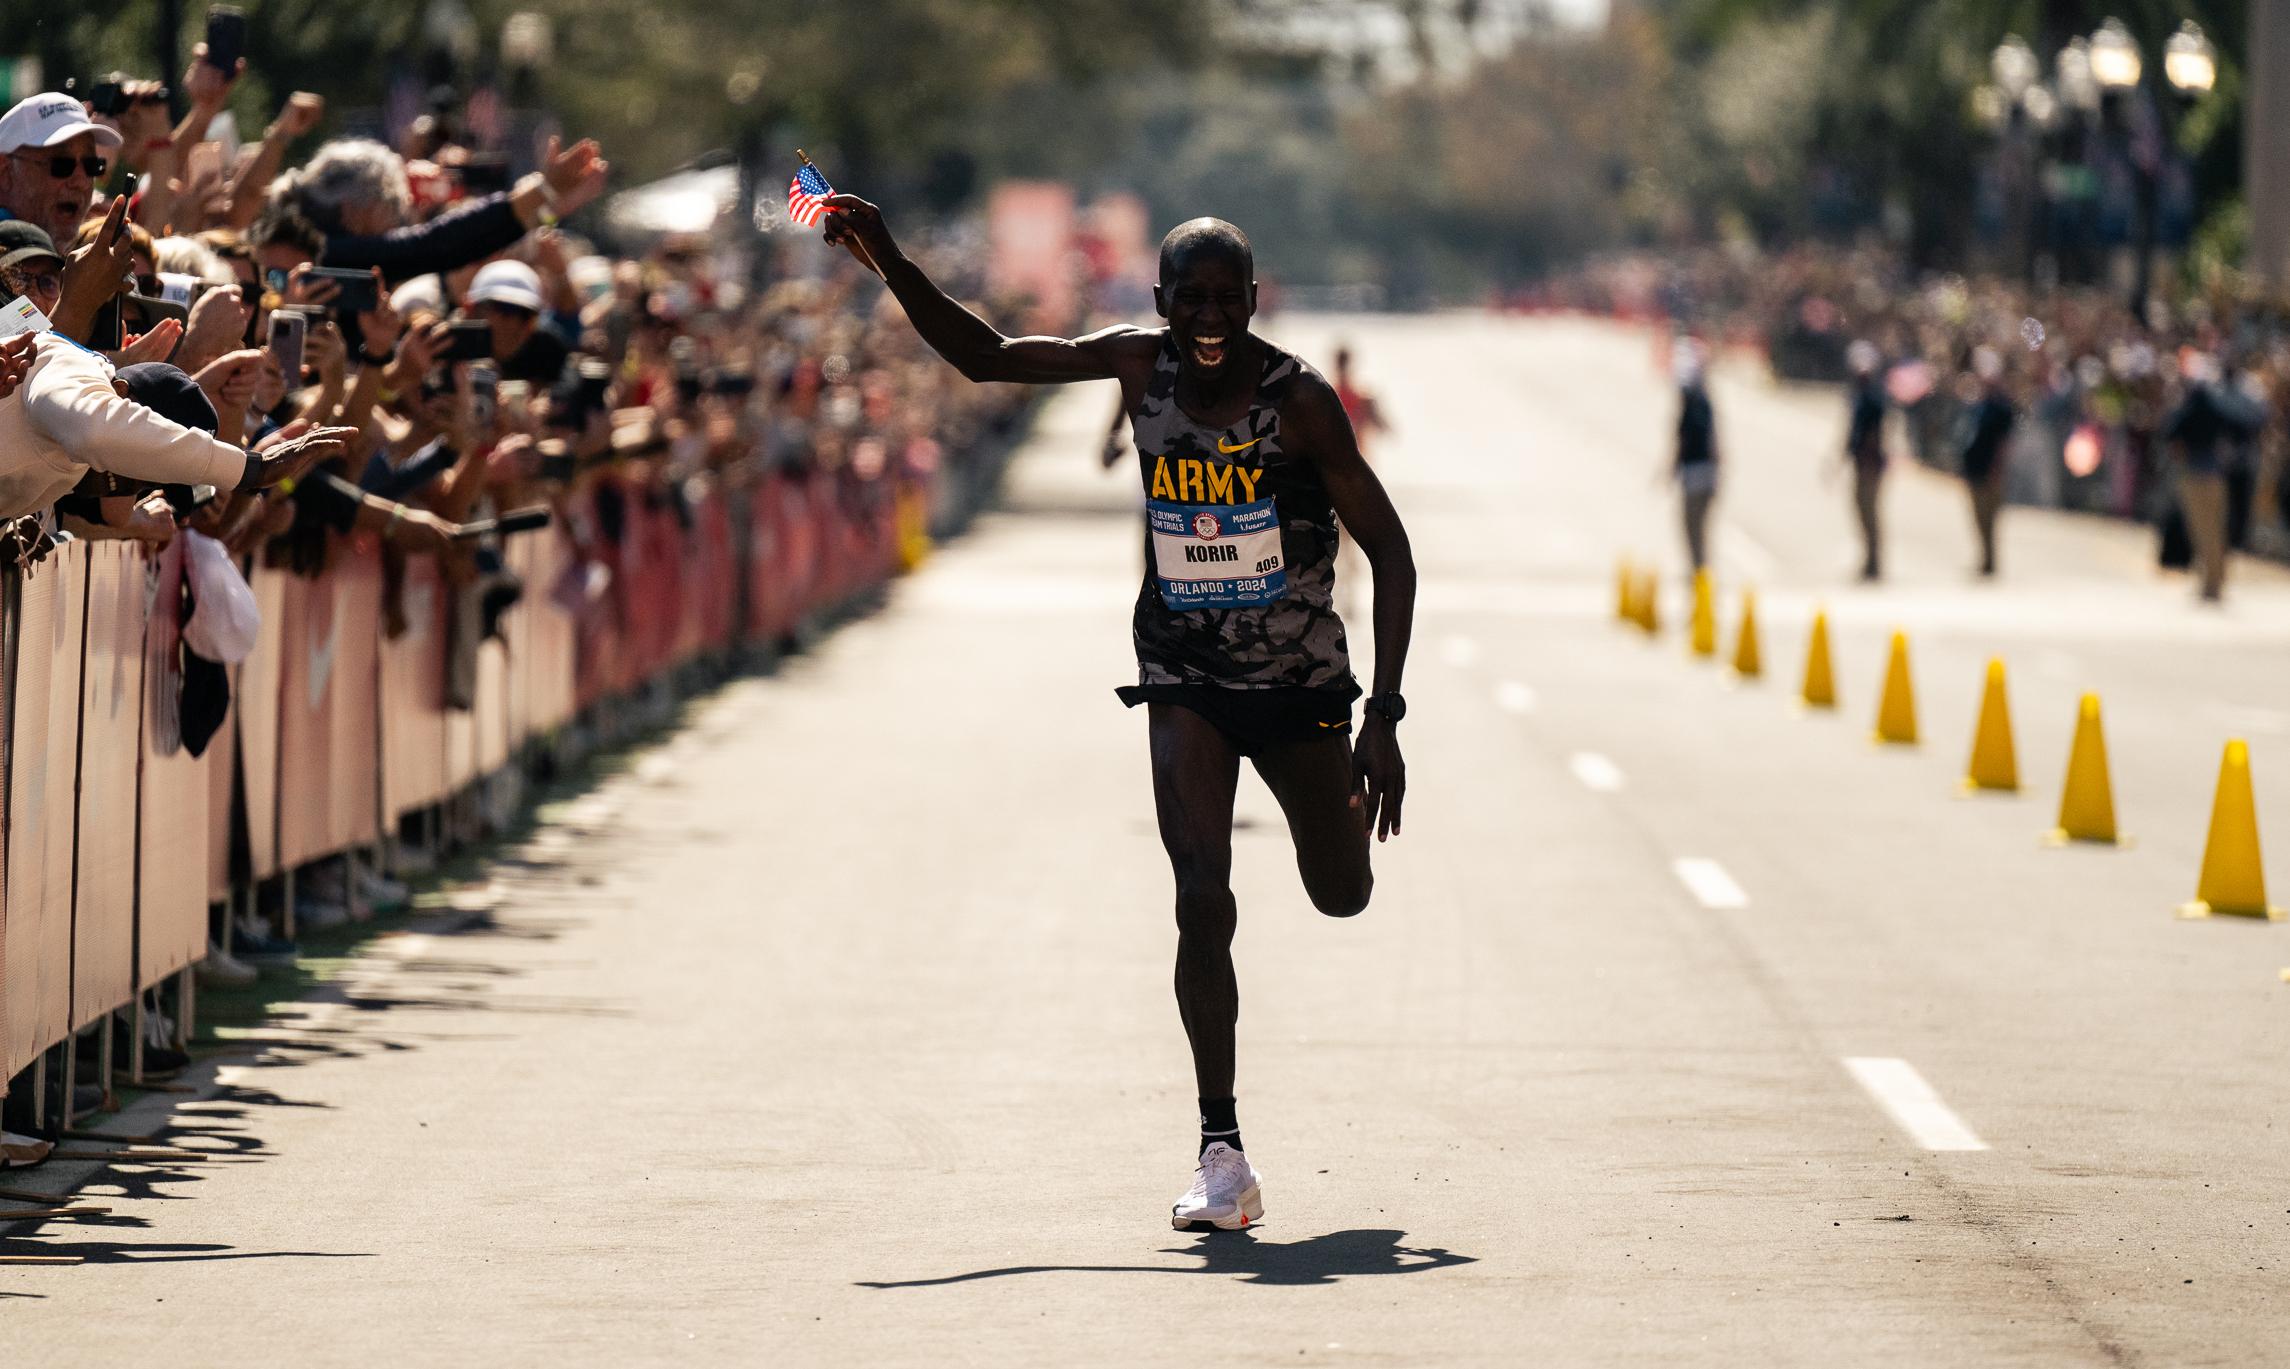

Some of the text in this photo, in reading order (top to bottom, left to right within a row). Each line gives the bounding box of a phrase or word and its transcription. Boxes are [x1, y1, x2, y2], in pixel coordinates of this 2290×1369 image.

[1152, 456, 1263, 505] ARMY
[1157, 511, 1182, 522] OLYMPIC
[1232, 508, 1271, 523] MARATHON
[1163, 520, 1185, 532] TRIALS
[1184, 545, 1238, 562] KORIR
[1255, 556, 1279, 573] 409
[1170, 582, 1224, 595] ORLANDO
[1236, 578, 1267, 592] 2024
